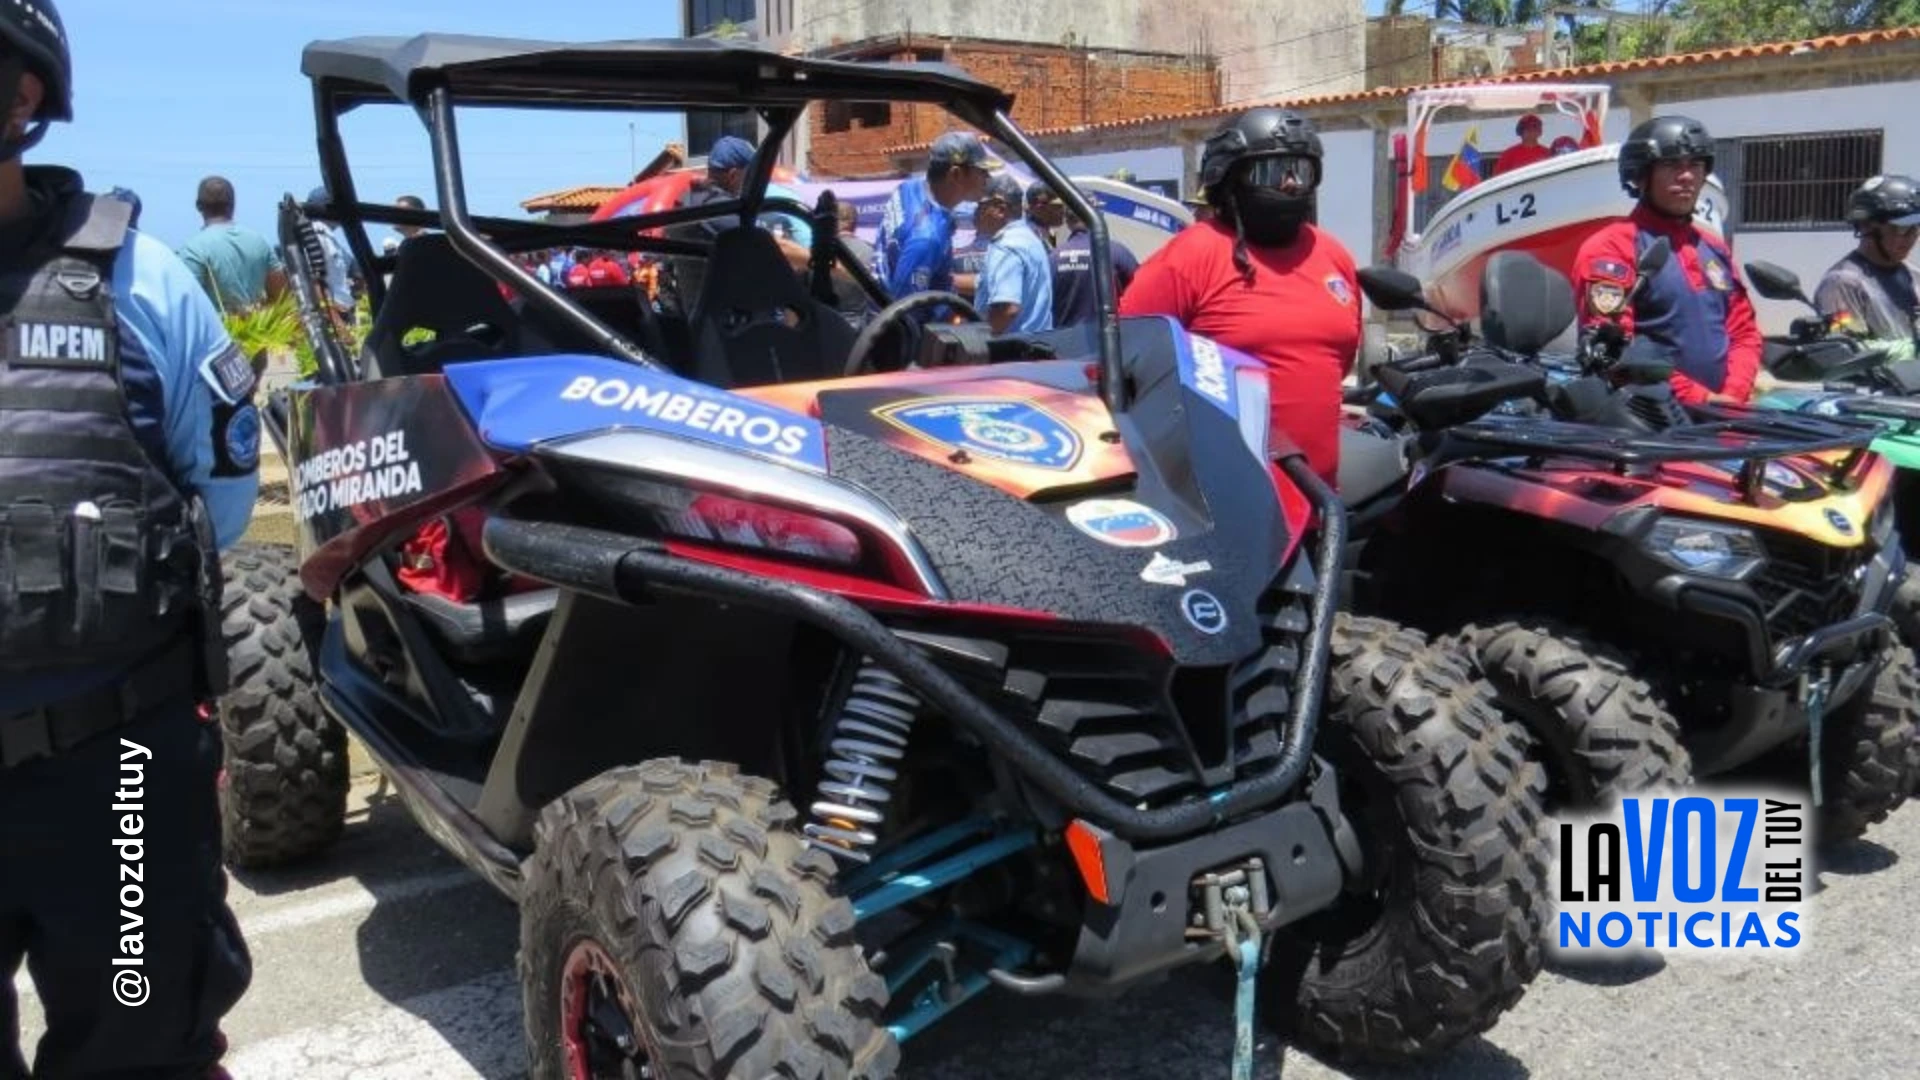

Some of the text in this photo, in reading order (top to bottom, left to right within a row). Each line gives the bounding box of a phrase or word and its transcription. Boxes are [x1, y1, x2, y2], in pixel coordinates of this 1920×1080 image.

[1496, 192, 1536, 225] L-2
[21, 323, 104, 361] IAPEM
[560, 375, 808, 454] BOMBEROS
[371, 429, 409, 467] DEL
[330, 461, 422, 510] MIRANDA
